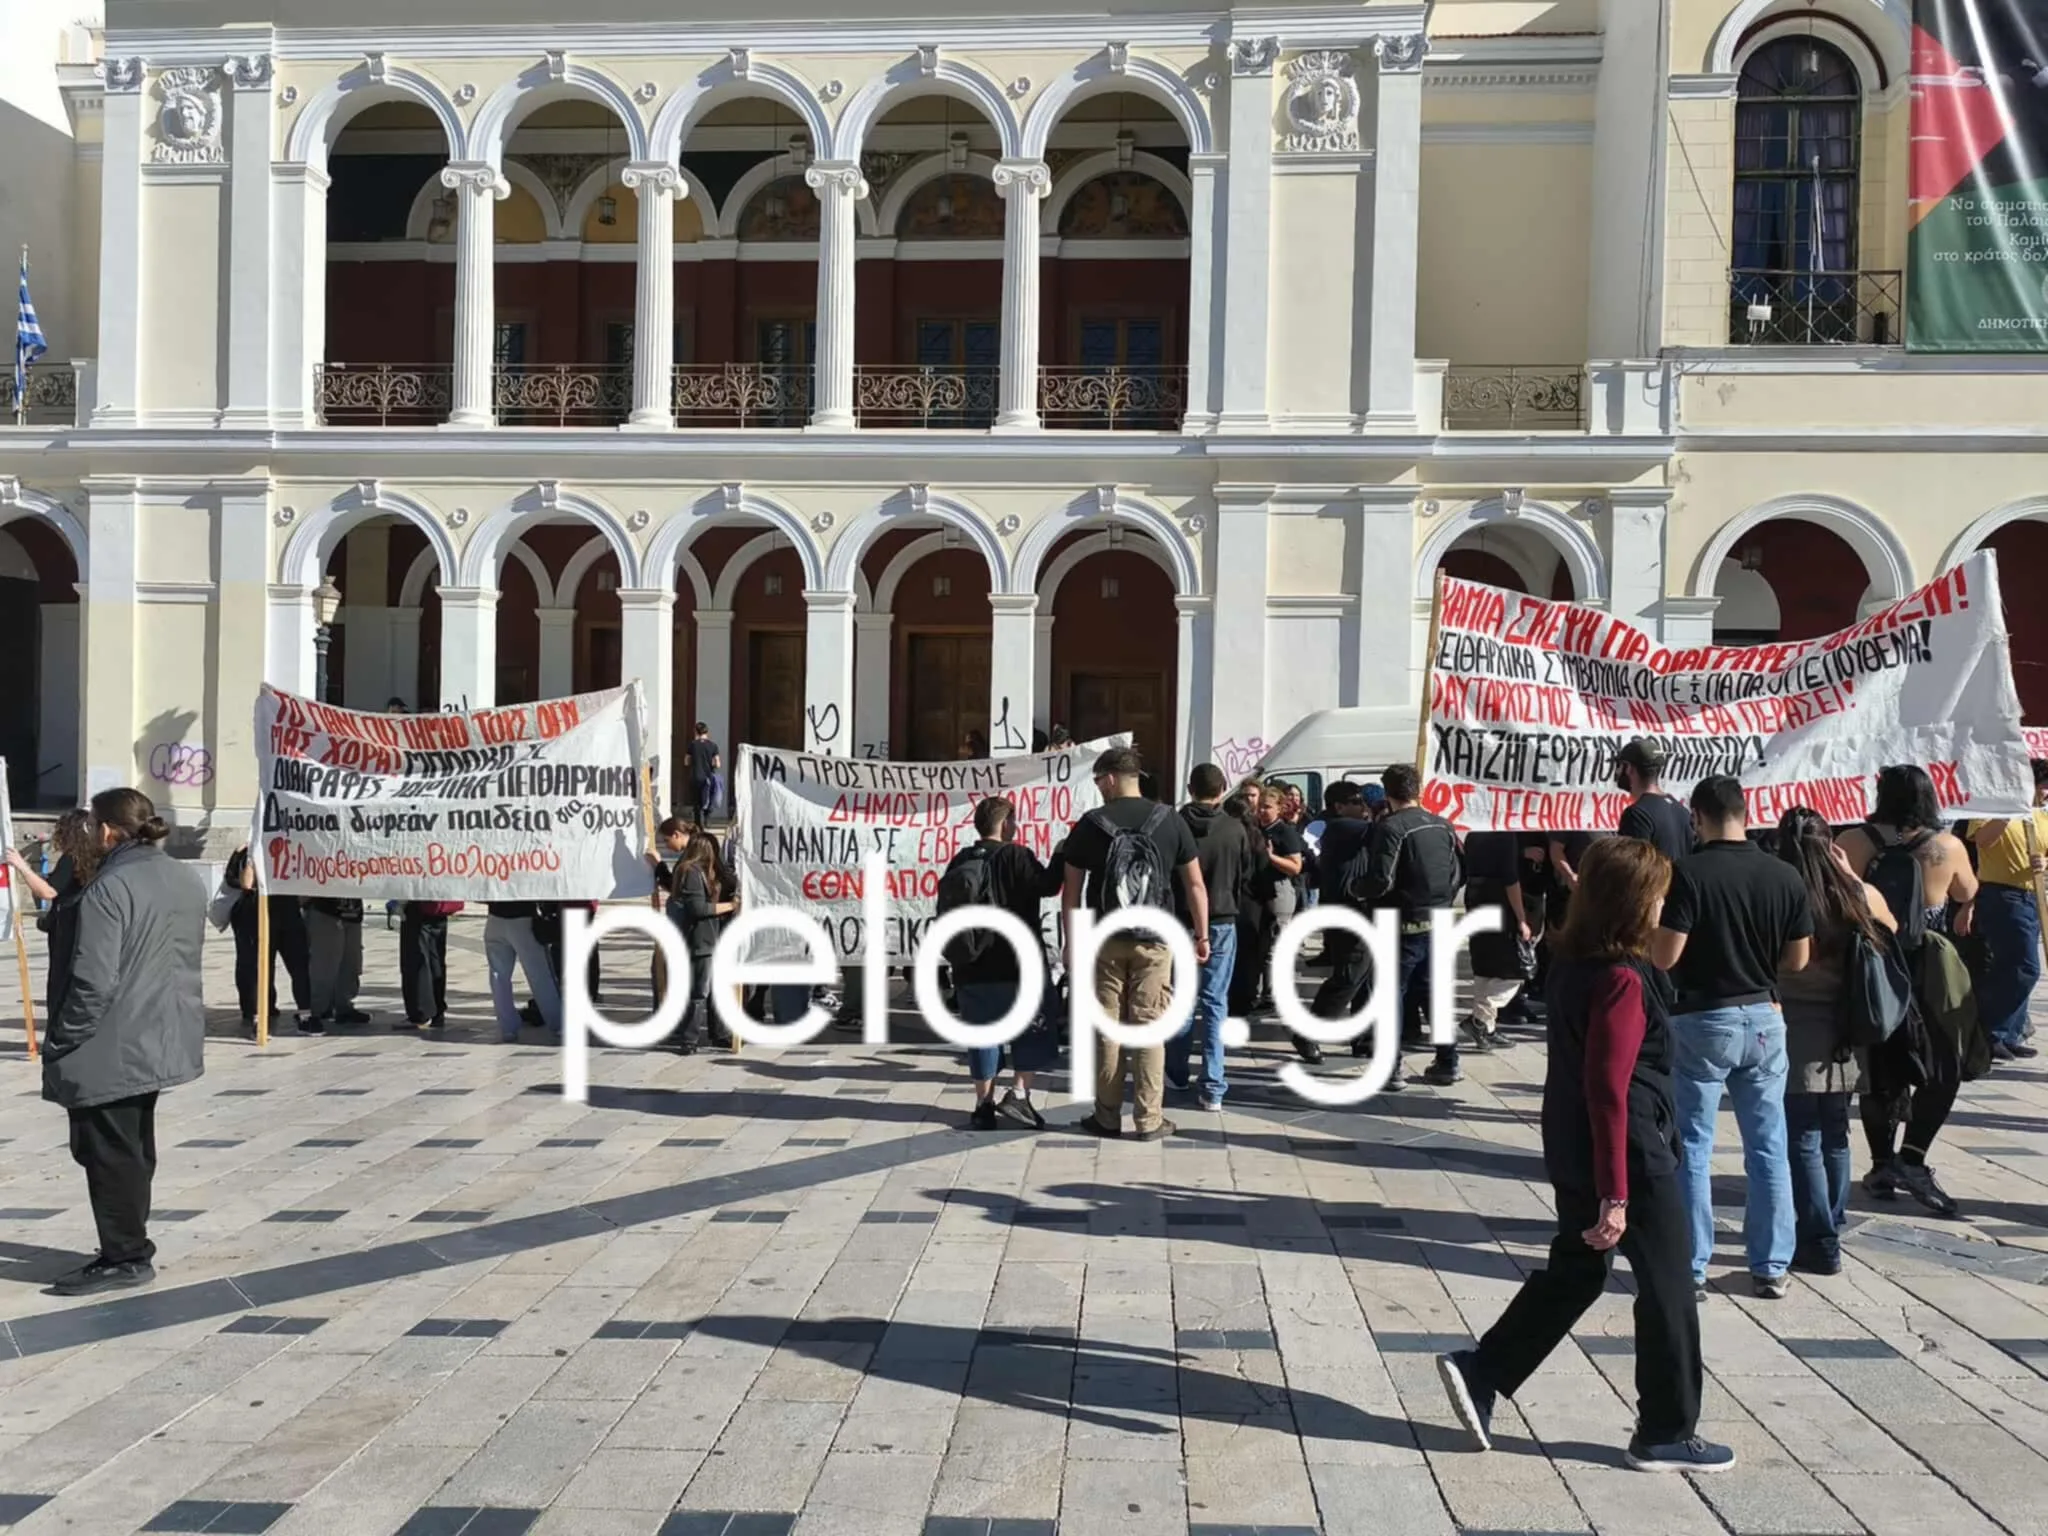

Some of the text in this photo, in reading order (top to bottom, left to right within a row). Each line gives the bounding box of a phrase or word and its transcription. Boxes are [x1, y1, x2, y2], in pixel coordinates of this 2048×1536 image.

[1950, 198, 1975, 212] Να
[1967, 216, 1992, 226] του
[1933, 252, 1959, 261] στο
[1441, 578, 1506, 639] ΚΑΜΙΑ
[1504, 597, 1604, 656] ΣΚΕΨΗ
[1599, 619, 1650, 663] ΓΙΑ
[1435, 631, 1537, 681] ΕΙΘΑΡΧΙΚΑ
[1542, 651, 1633, 699] ΣΥΜΒΟΥΛΙΑ
[1822, 619, 1932, 684] ΠΟΥΘΕΝΑ!
[273, 690, 307, 729] ΤΟ
[305, 701, 470, 751] ΠΑΝΕΠΙΣΤΗΜΙΟ
[471, 708, 533, 746] ΤΟΥΣ
[1443, 675, 1578, 730] ΑΥΤΑΡΧΙΣΜΟΣ
[1700, 703, 1740, 736] ΘΑ
[1736, 679, 1857, 735] ΠΕΡΑΣΕΙ!
[270, 725, 317, 759] ΜΑΣ
[273, 757, 387, 801] ΔΙΑΓΡΑΦΕΣ
[752, 753, 1072, 791] ΝΑ ΠΡΟΣΤΑΤΕΨΟΥΜΕ ΤΟ
[350, 804, 438, 838] δωρεάν
[448, 803, 553, 833] παιδεία
[583, 803, 635, 835] όλους
[828, 791, 950, 828] ΔΗΜΟΣΙΟ
[427, 841, 561, 882] Βιολογικού
[760, 826, 860, 864] ΕΝΑΝΤΙΑ
